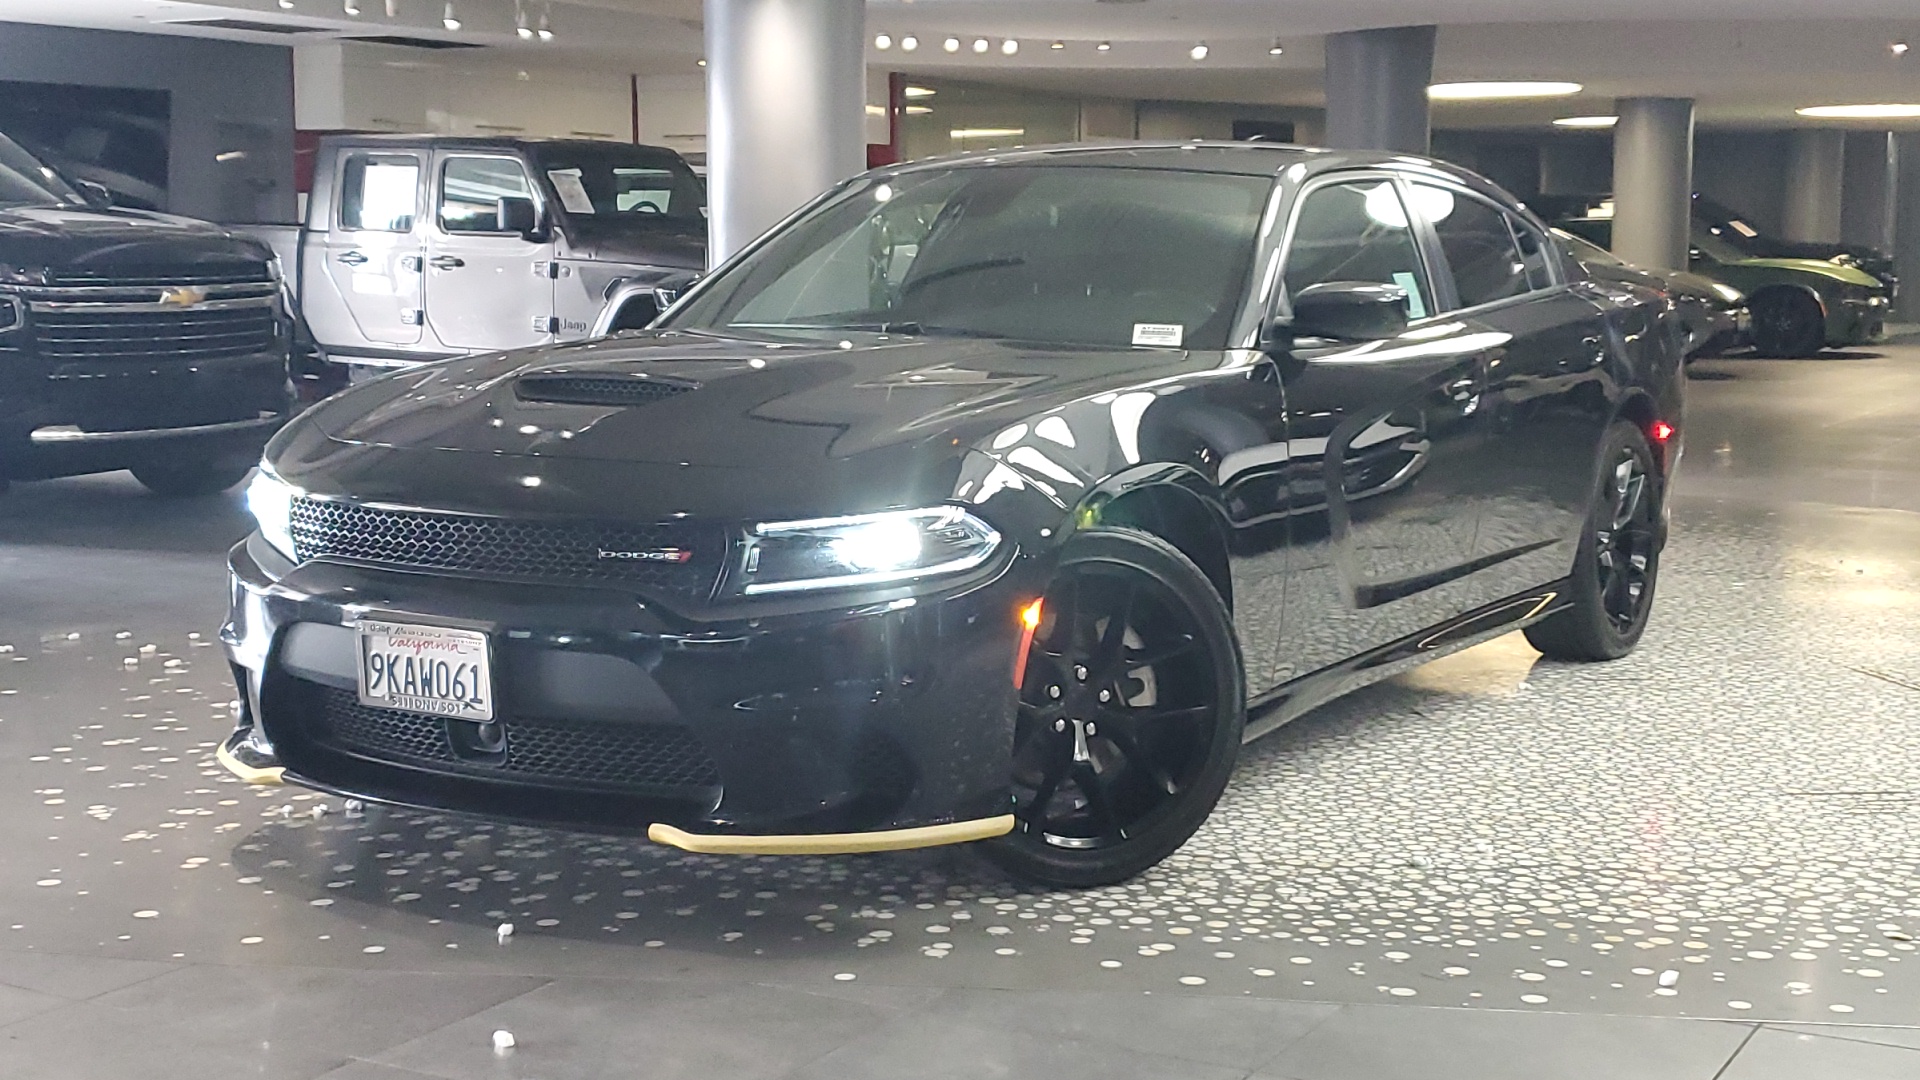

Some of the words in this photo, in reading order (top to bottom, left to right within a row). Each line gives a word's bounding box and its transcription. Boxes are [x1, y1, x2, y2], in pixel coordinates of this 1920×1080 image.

[600, 551, 681, 560] DODGE
[388, 636, 467, 655] California
[371, 652, 483, 704] 9KAW061
